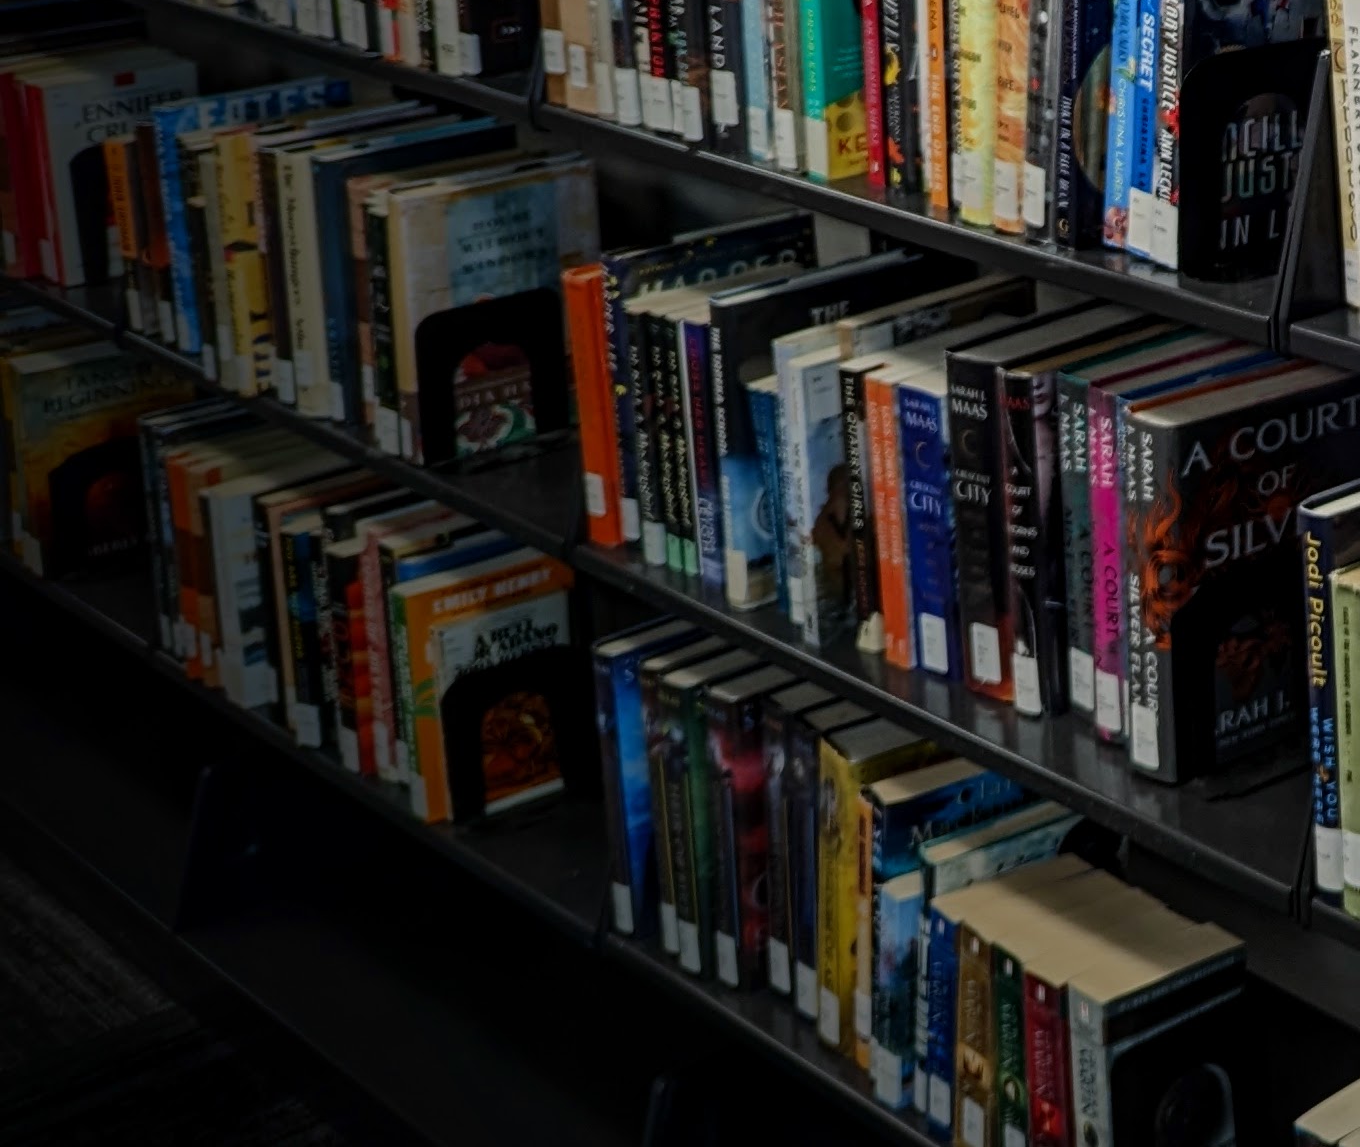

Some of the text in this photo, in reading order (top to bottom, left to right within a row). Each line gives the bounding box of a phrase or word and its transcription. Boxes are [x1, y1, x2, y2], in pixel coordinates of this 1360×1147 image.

[1139, 12, 1155, 92] SECRET
[951, 397, 989, 421] MAAS
[1140, 431, 1156, 502] SARAH
[1181, 440, 1212, 478] A
[954, 480, 993, 507] CITY
[1258, 462, 1297, 497] OF
[1305, 531, 1328, 690] Jodi Picoult
